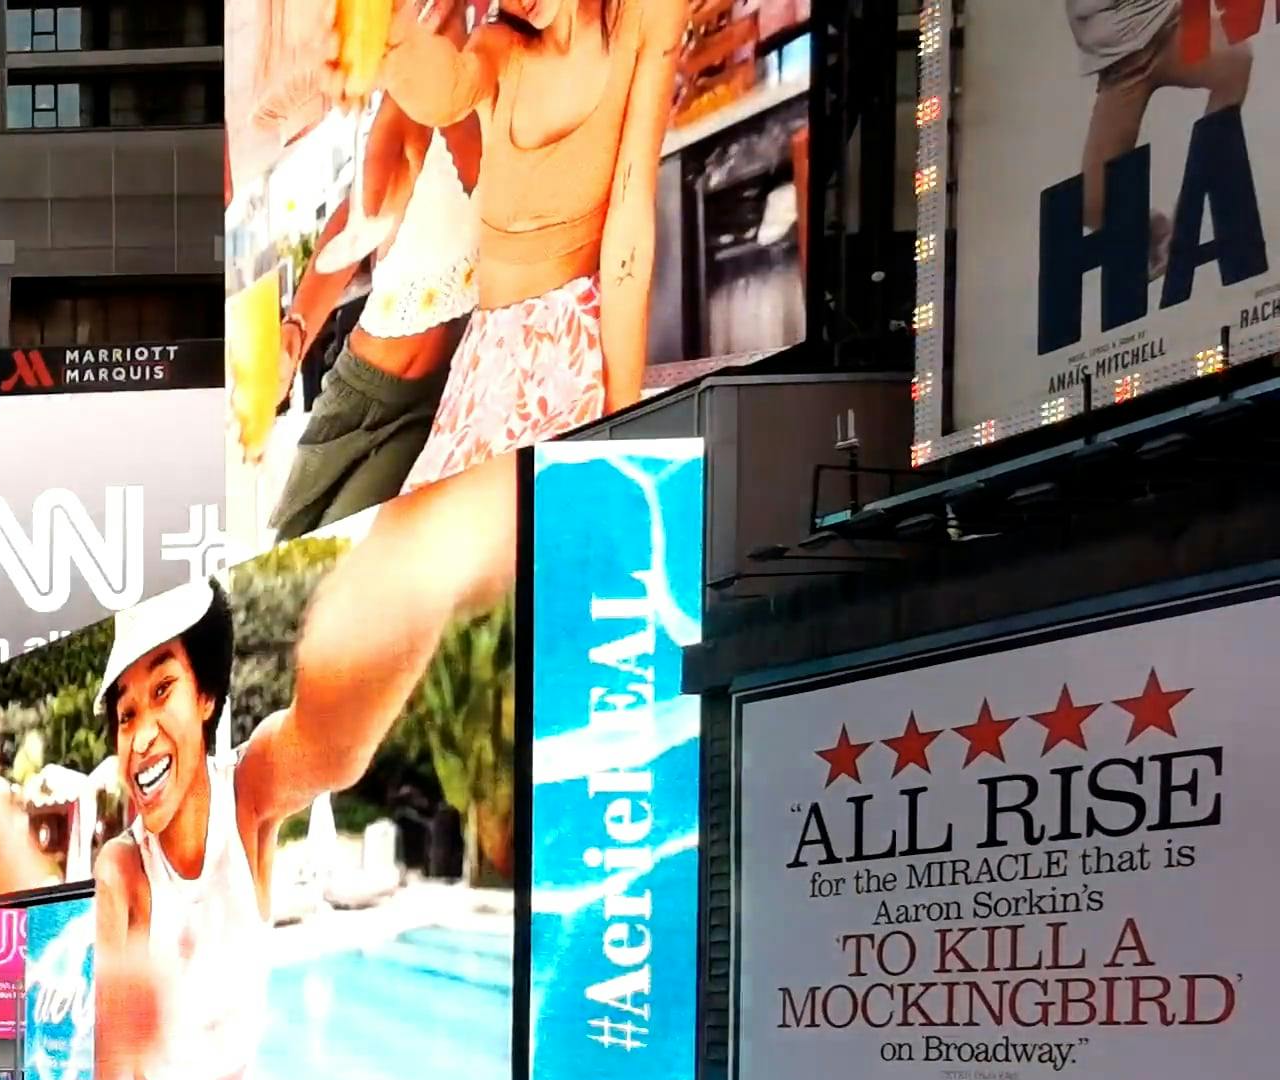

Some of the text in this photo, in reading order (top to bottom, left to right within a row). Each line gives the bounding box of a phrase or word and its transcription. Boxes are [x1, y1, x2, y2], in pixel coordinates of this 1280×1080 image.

[65, 346, 178, 364] MARRIOTT
[65, 365, 165, 382] MARQUIS
[1095, 338, 1166, 379] MITCHELL
[583, 570, 656, 1053] #AerieREAL
[976, 746, 1224, 849] RISE
[809, 839, 1196, 898] for the MIRACLE that is
[872, 885, 1104, 926] Aaron Sorkin's
[934, 922, 1085, 974] KILL
[1104, 918, 1155, 967] A
[881, 1041, 915, 1063] on
